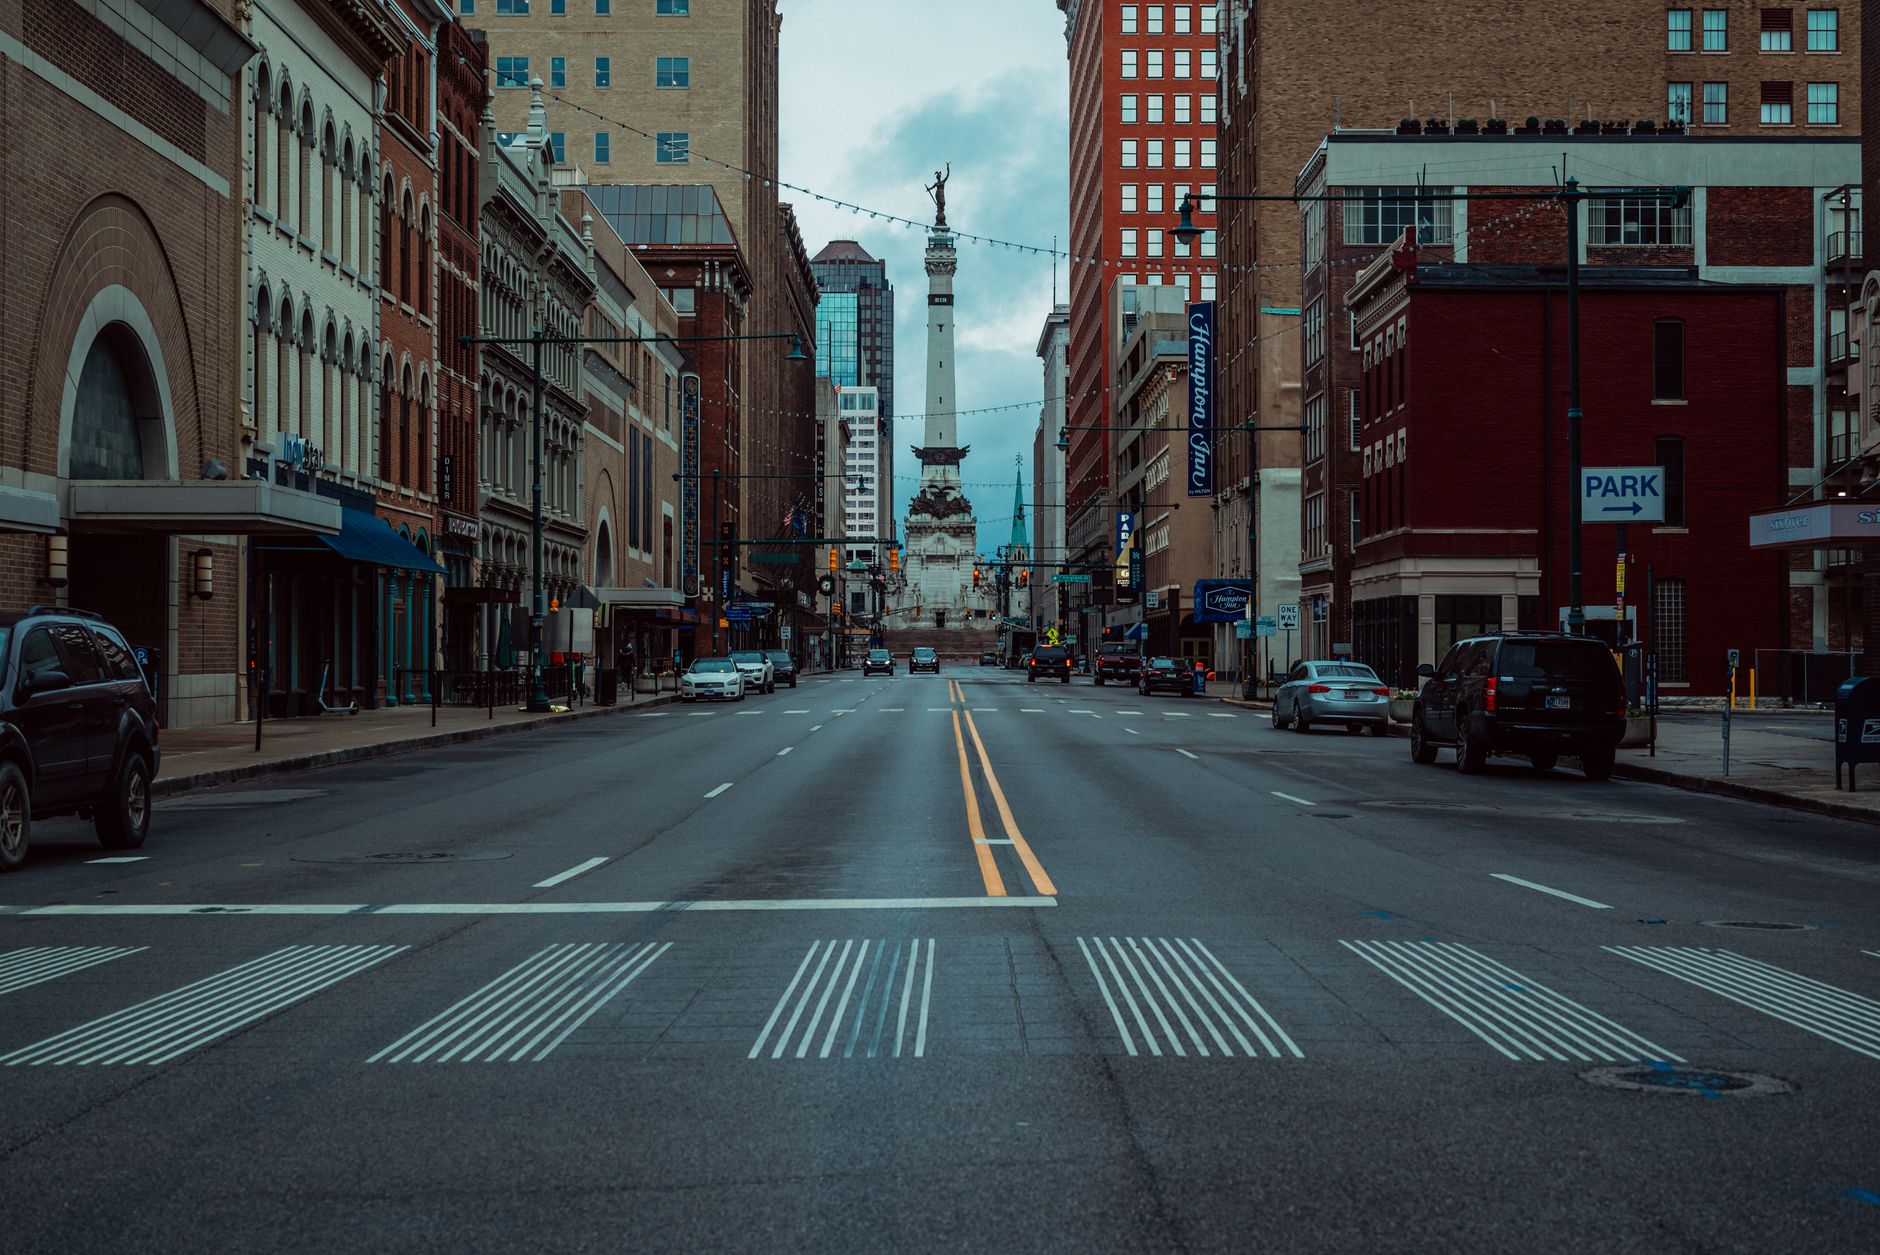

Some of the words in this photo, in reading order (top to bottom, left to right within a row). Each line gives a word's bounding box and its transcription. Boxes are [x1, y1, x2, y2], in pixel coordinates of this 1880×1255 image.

[1189, 313, 1210, 429] Hampton
[283, 432, 323, 471] IndyStar
[1189, 432, 1210, 487] Inn
[1586, 475, 1659, 497] PARK
[1210, 594, 1247, 604] Hampton
[1219, 601, 1240, 609] Inn
